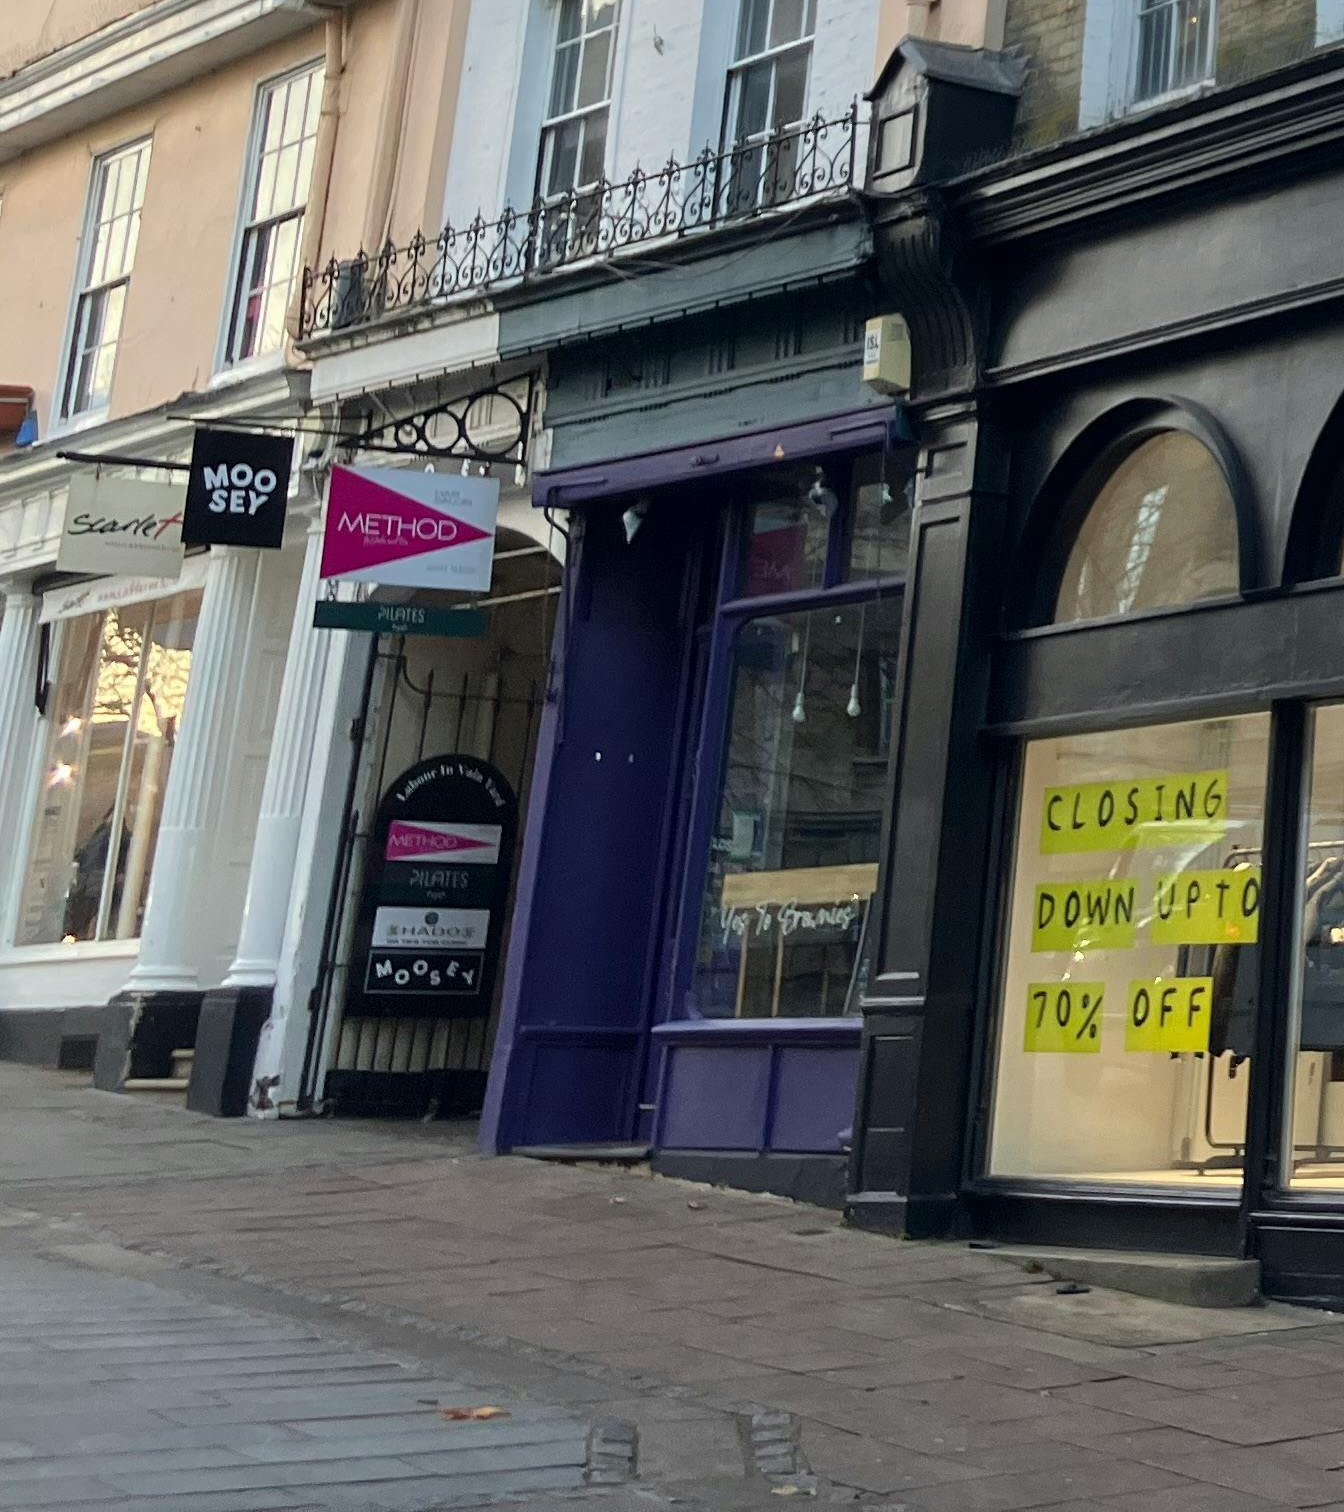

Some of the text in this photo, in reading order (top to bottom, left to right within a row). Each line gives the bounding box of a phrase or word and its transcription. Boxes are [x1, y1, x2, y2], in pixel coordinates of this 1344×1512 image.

[203, 463, 277, 493] MOO
[208, 489, 269, 515] SEY
[337, 511, 457, 541] METHOD
[378, 606, 425, 623] PILATES
[1047, 779, 1222, 831] CLOSING
[390, 833, 458, 848] METHOD
[410, 869, 469, 889] PILATES
[1038, 888, 1134, 929] DOWN
[375, 959, 475, 986] MOOSEY
[1033, 987, 1206, 1039] 70% OFF
